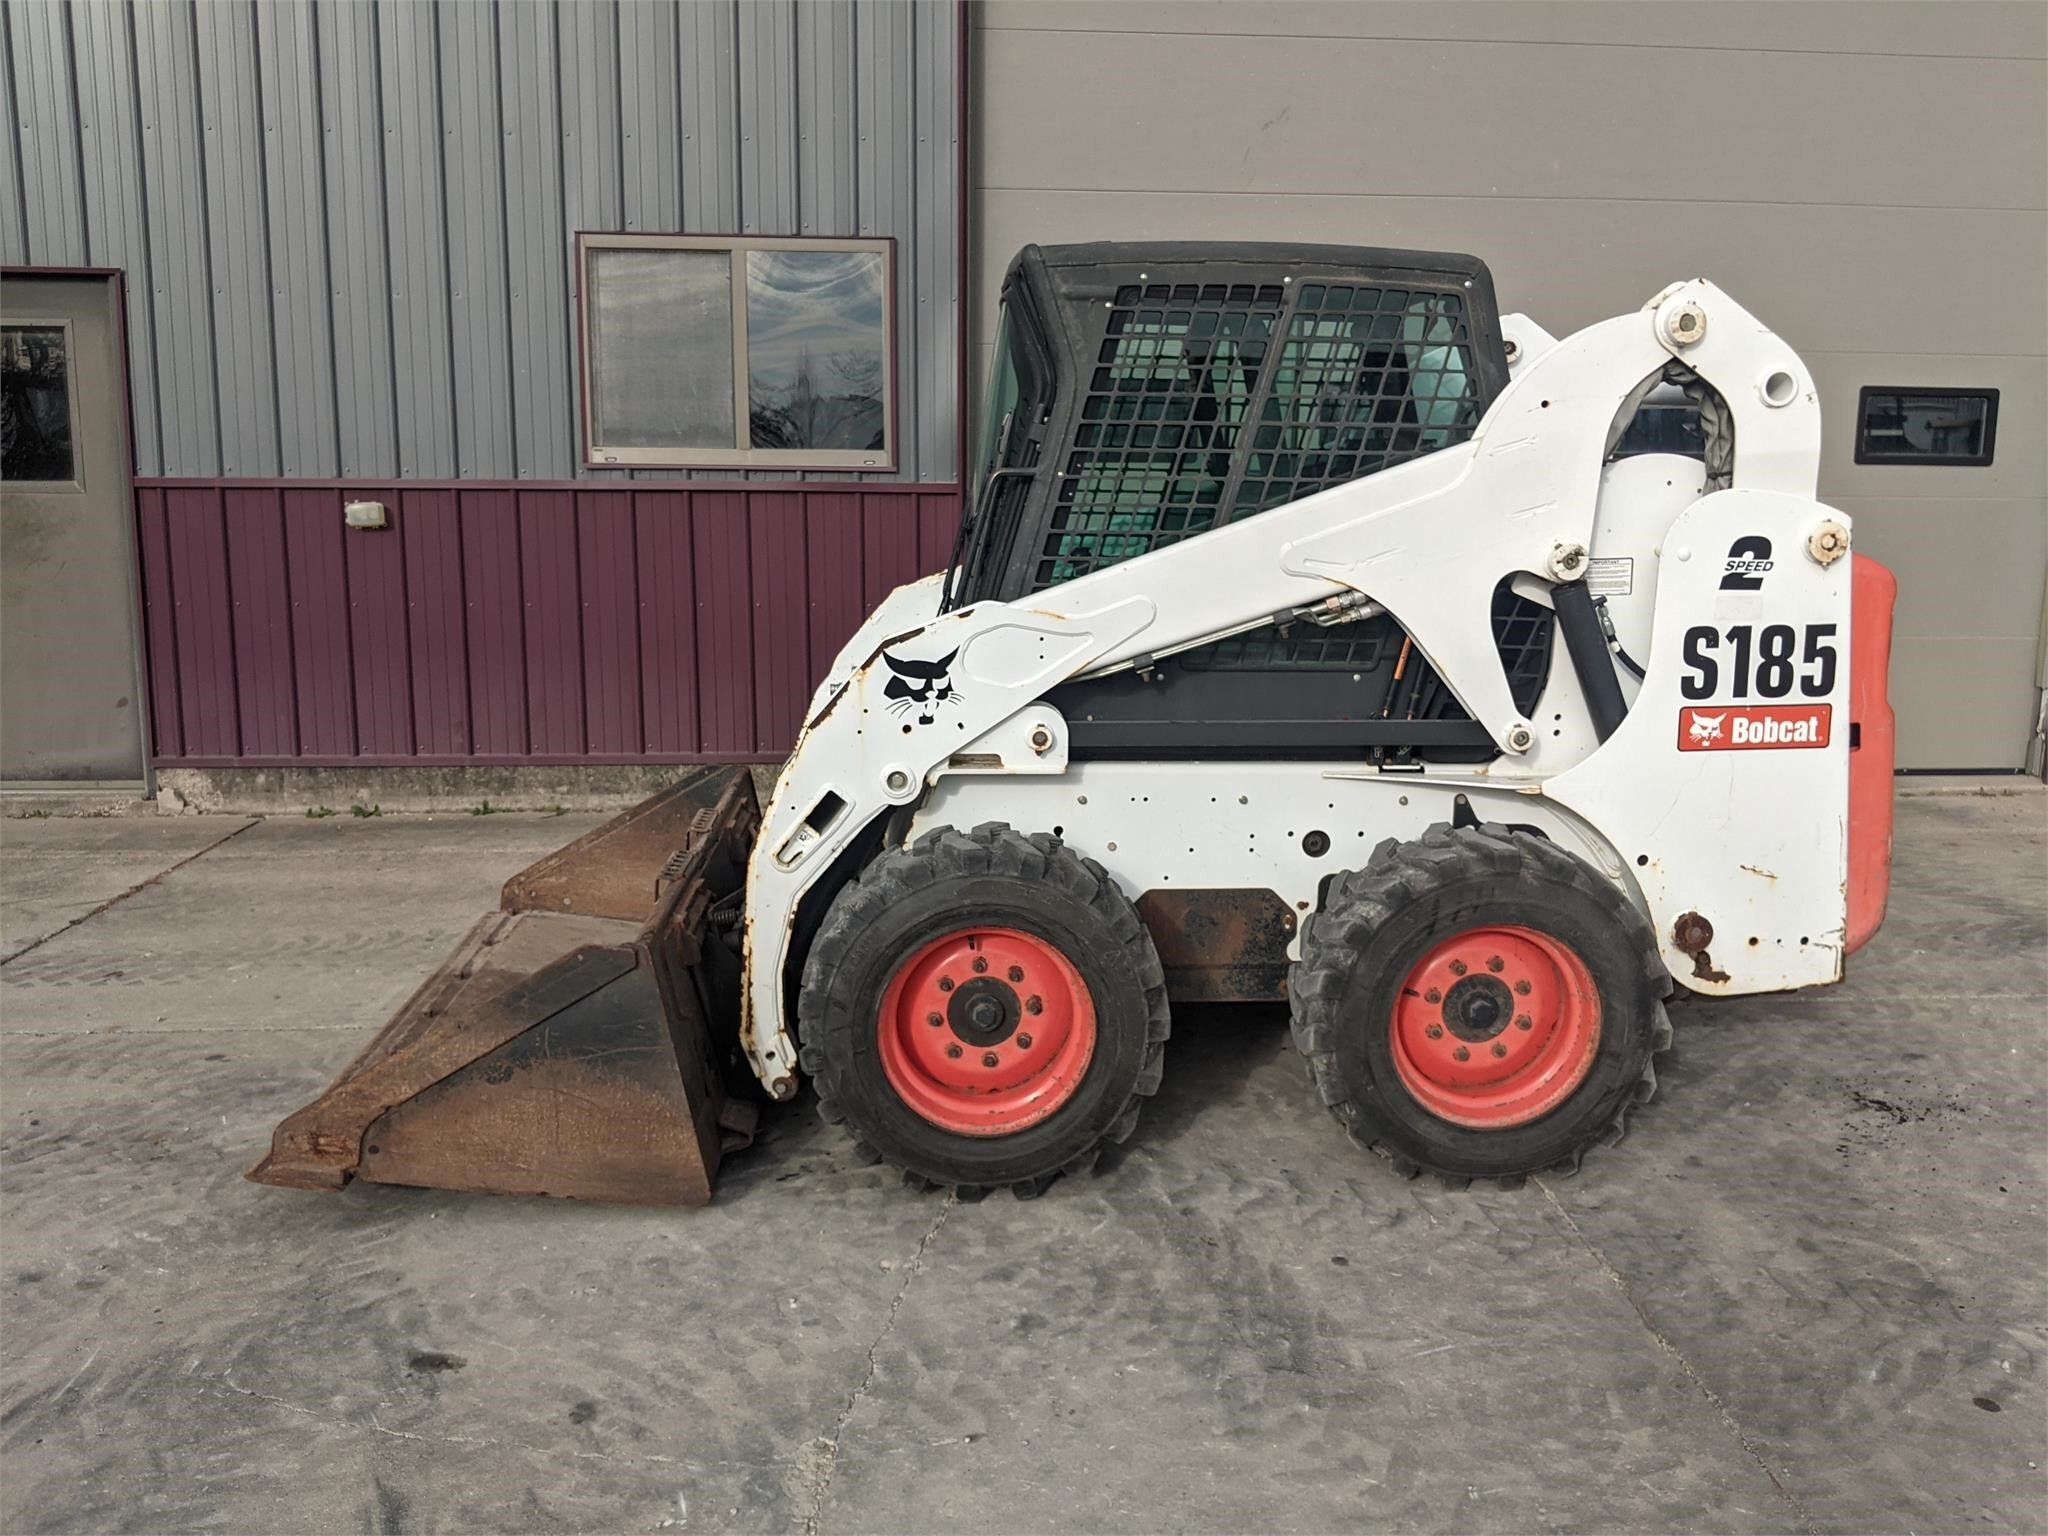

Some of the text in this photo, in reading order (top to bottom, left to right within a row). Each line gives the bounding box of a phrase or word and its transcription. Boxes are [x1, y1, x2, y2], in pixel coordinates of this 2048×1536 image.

[1719, 535, 1772, 590] 2
[1724, 560, 1774, 572] SPEED
[1681, 623, 1837, 700] S185
[1732, 716, 1817, 744] Bobcat
